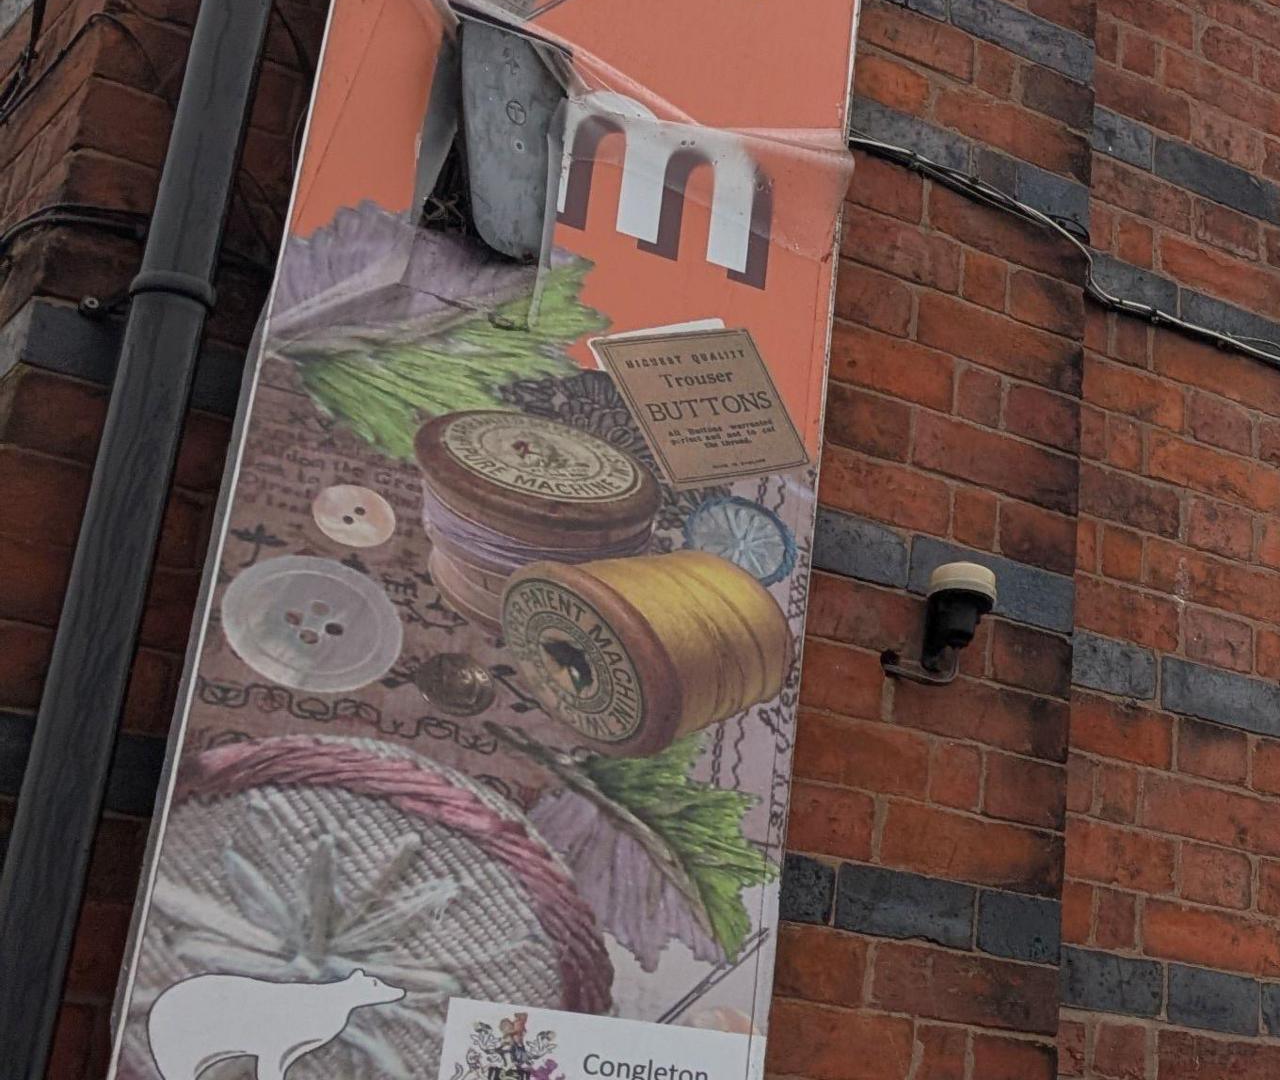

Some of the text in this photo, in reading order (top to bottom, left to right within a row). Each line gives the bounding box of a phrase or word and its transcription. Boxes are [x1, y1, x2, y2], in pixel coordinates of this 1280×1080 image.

[691, 349, 745, 365] QUALITY
[658, 370, 734, 389] Trouser
[645, 390, 772, 422] BUTTONS
[454, 446, 507, 477] PURE
[514, 473, 622, 497] MACHINE
[520, 587, 586, 622] PATENT
[588, 623, 637, 731] MACHINE
[583, 1053, 708, 1080] Congleton
